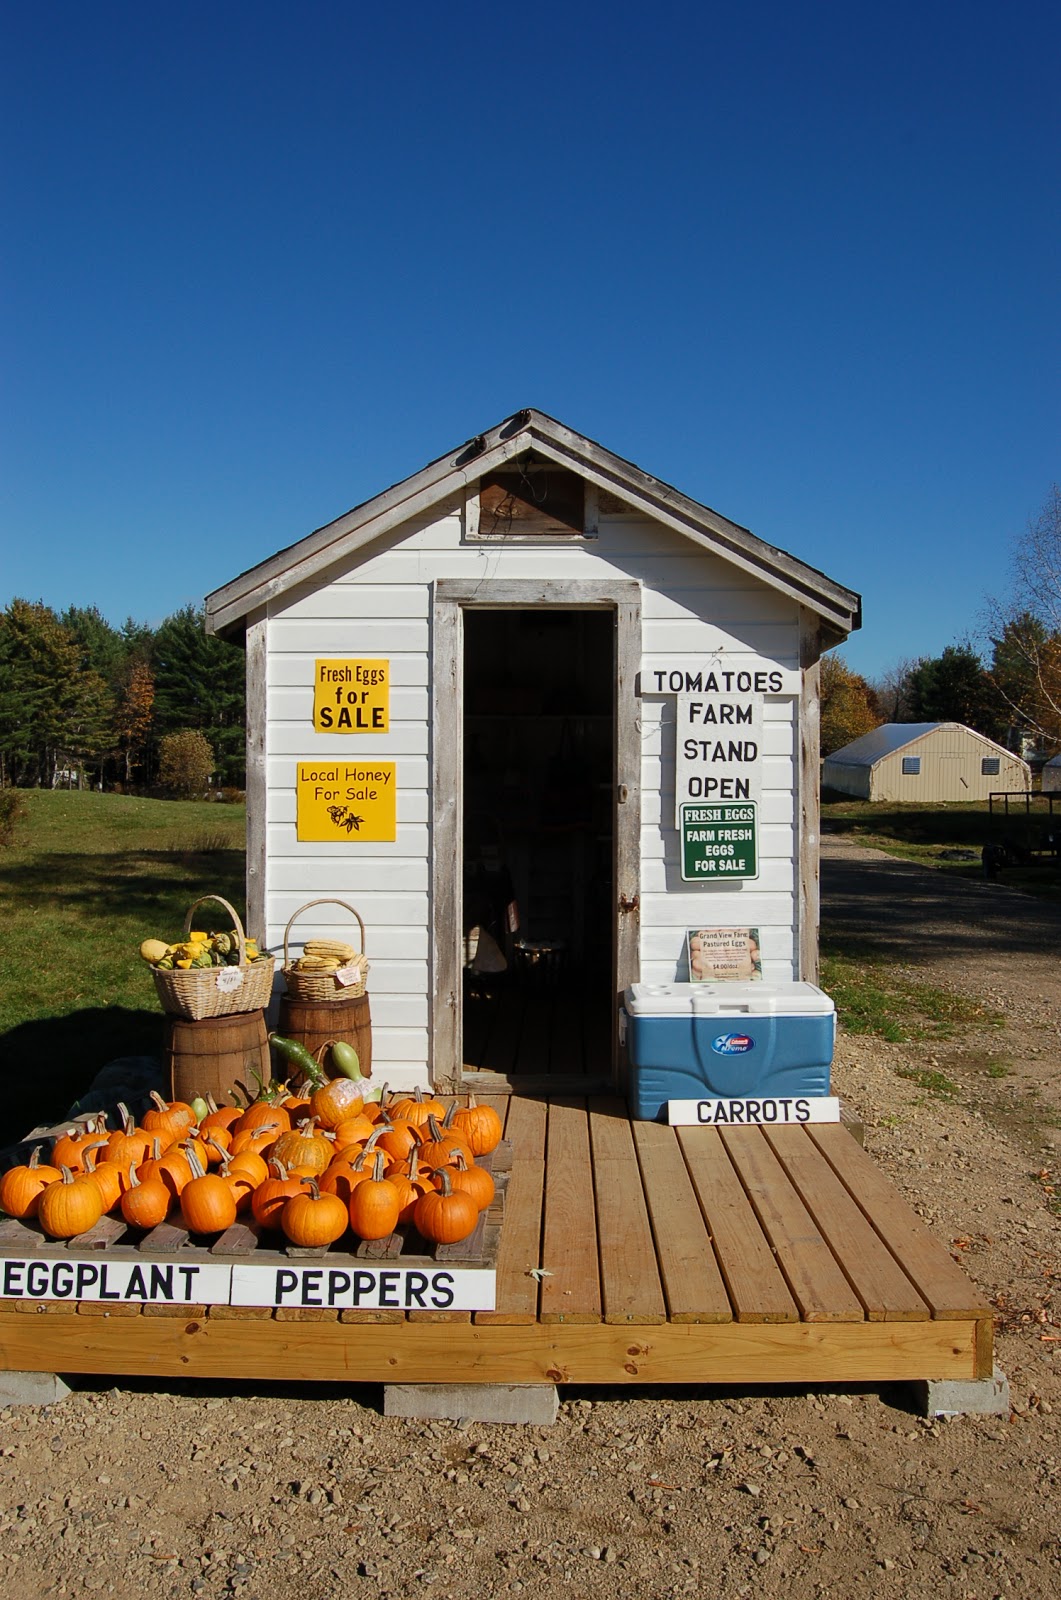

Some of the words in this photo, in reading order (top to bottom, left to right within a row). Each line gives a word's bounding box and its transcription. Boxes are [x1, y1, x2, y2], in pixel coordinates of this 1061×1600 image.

[320, 666, 352, 682] Fresh
[356, 666, 385, 685] Eggs
[653, 671, 783, 692] TOMATOES
[335, 687, 370, 704] for
[320, 707, 385, 728] SALE
[689, 703, 753, 724] FARM
[684, 739, 758, 762] STAND
[301, 768, 339, 782] Local
[345, 768, 391, 784] Honey
[314, 787, 340, 800] For
[345, 787, 378, 800] Sale
[688, 777, 750, 799] OPEN
[684, 809, 721, 822] FRESH
[724, 808, 754, 821] EGGS
[686, 830, 715, 842] FARM
[717, 829, 752, 841] FRESH
[705, 844, 735, 856] EGGS
[694, 861, 716, 872] FOR
[718, 859, 746, 871] SALE
[697, 1099, 811, 1123] CARROTS
[3, 1262, 199, 1301] EGGPLANT
[275, 1269, 456, 1308] PEPPERS
